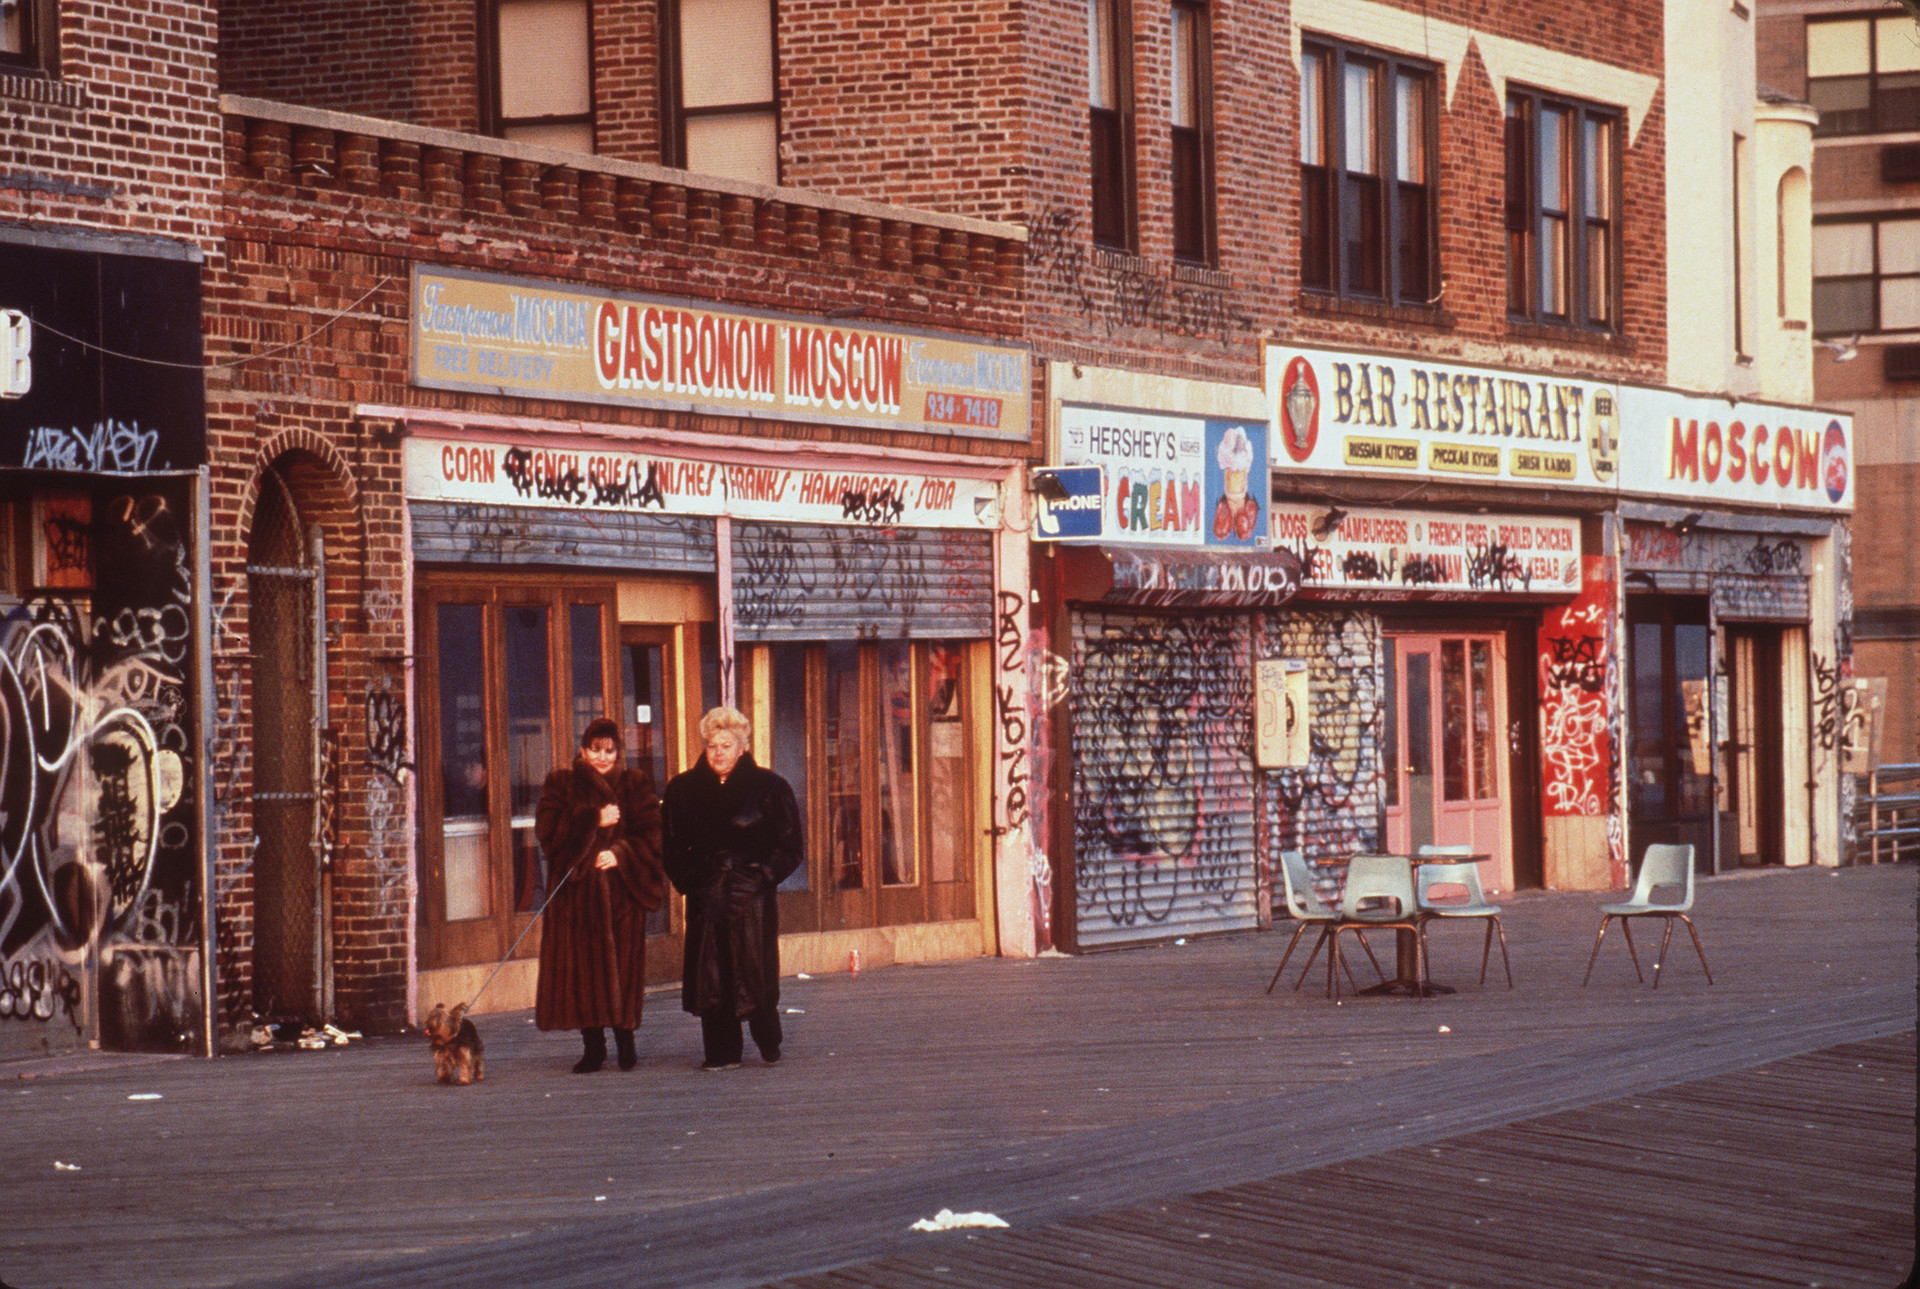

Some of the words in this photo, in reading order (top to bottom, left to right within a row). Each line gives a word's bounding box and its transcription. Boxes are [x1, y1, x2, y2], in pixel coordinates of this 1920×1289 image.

[434, 345, 469, 373] FREE
[479, 350, 556, 382] DELIVERY
[594, 301, 775, 403] GASTRONOM
[1333, 361, 1397, 428] BAR
[1411, 368, 1583, 442] RESTAURANT
[1089, 425, 1176, 460] HERSHEY'S
[1348, 442, 1382, 459] RUSSIAN
[1385, 444, 1418, 461] KITCHEN
[1667, 415, 1820, 490] MOSCOW
[442, 445, 495, 483] CORN
[728, 466, 791, 502] FRANKS
[915, 478, 956, 510] SODA
[1518, 454, 1540, 471] SHISH
[1049, 494, 1101, 511] PHONE
[1116, 466, 1201, 532] CREAM
[1279, 512, 1308, 540] DOGS
[1338, 517, 1409, 545] HAMBURGERS
[1428, 521, 1463, 547] FRENCH
[1465, 523, 1488, 548] FRIES
[1536, 526, 1573, 551] CHICKEN
